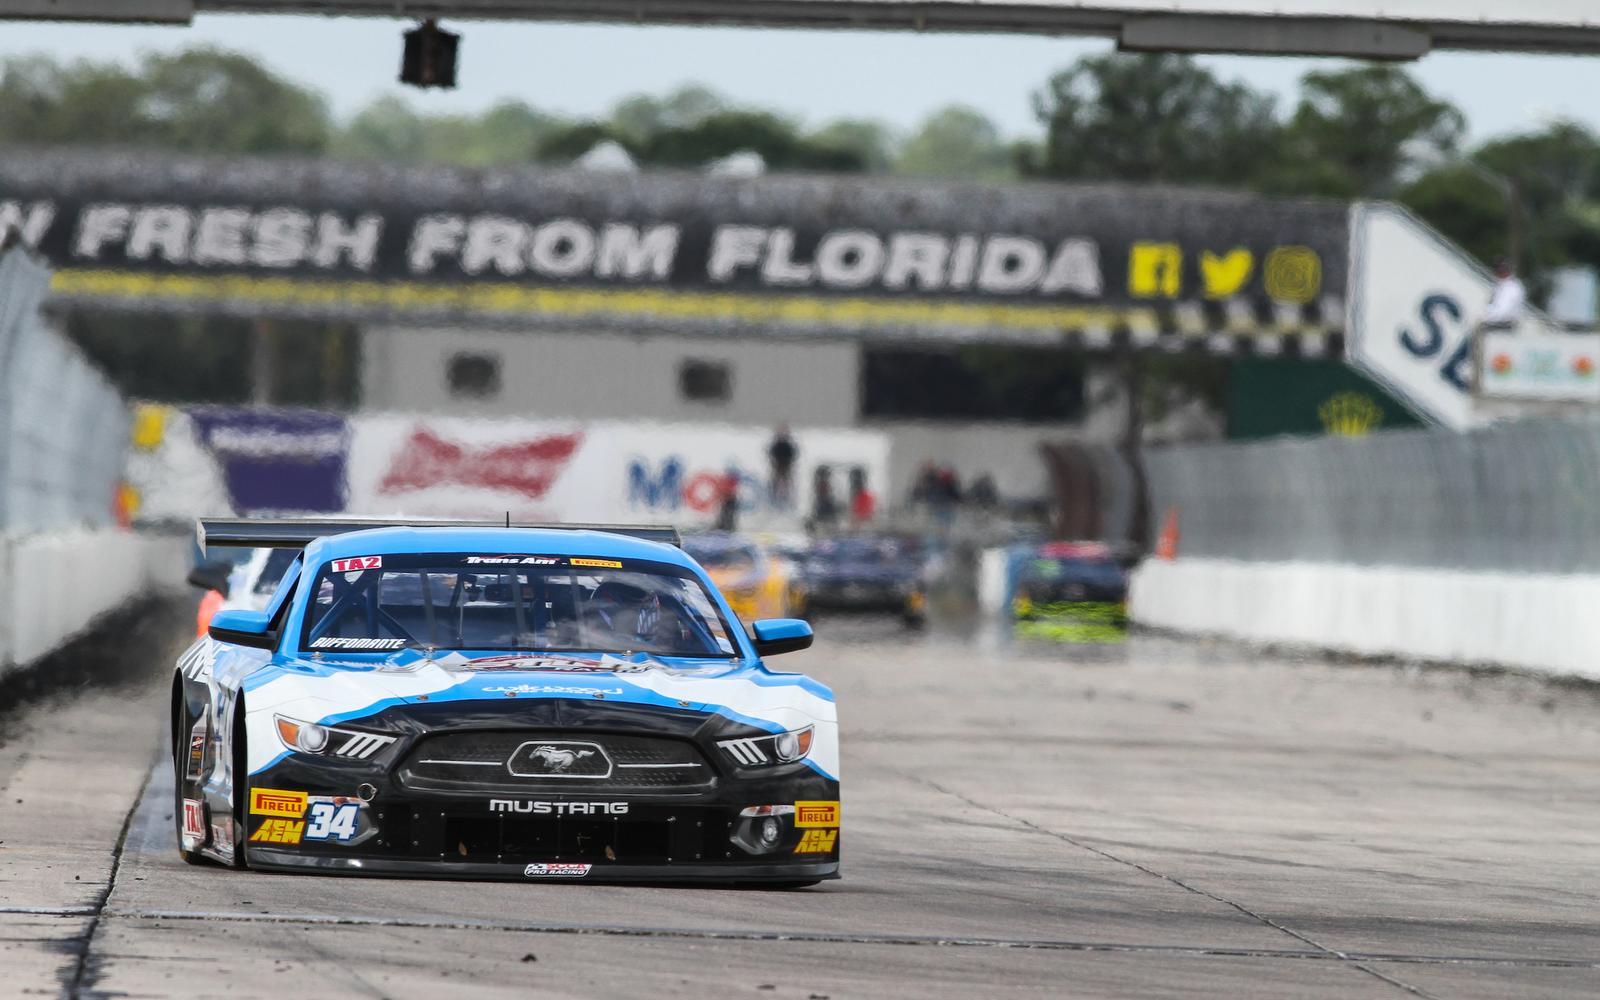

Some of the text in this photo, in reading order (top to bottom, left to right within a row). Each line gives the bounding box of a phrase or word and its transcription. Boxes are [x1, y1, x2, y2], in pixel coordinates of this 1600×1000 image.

[74, 204, 382, 271] FRESH
[408, 213, 680, 280] FROM
[706, 223, 1104, 297] FLORIDA
[334, 557, 381, 571] TA2
[466, 556, 556, 565] Trans Am
[310, 637, 407, 649] BUFFOMANTE
[256, 794, 302, 813] PIRELLI
[489, 799, 629, 814] MUSTANG
[305, 802, 360, 840] 34
[798, 806, 835, 822] PIRELLI
[250, 819, 305, 844] AEM
[793, 830, 838, 853] AEM
